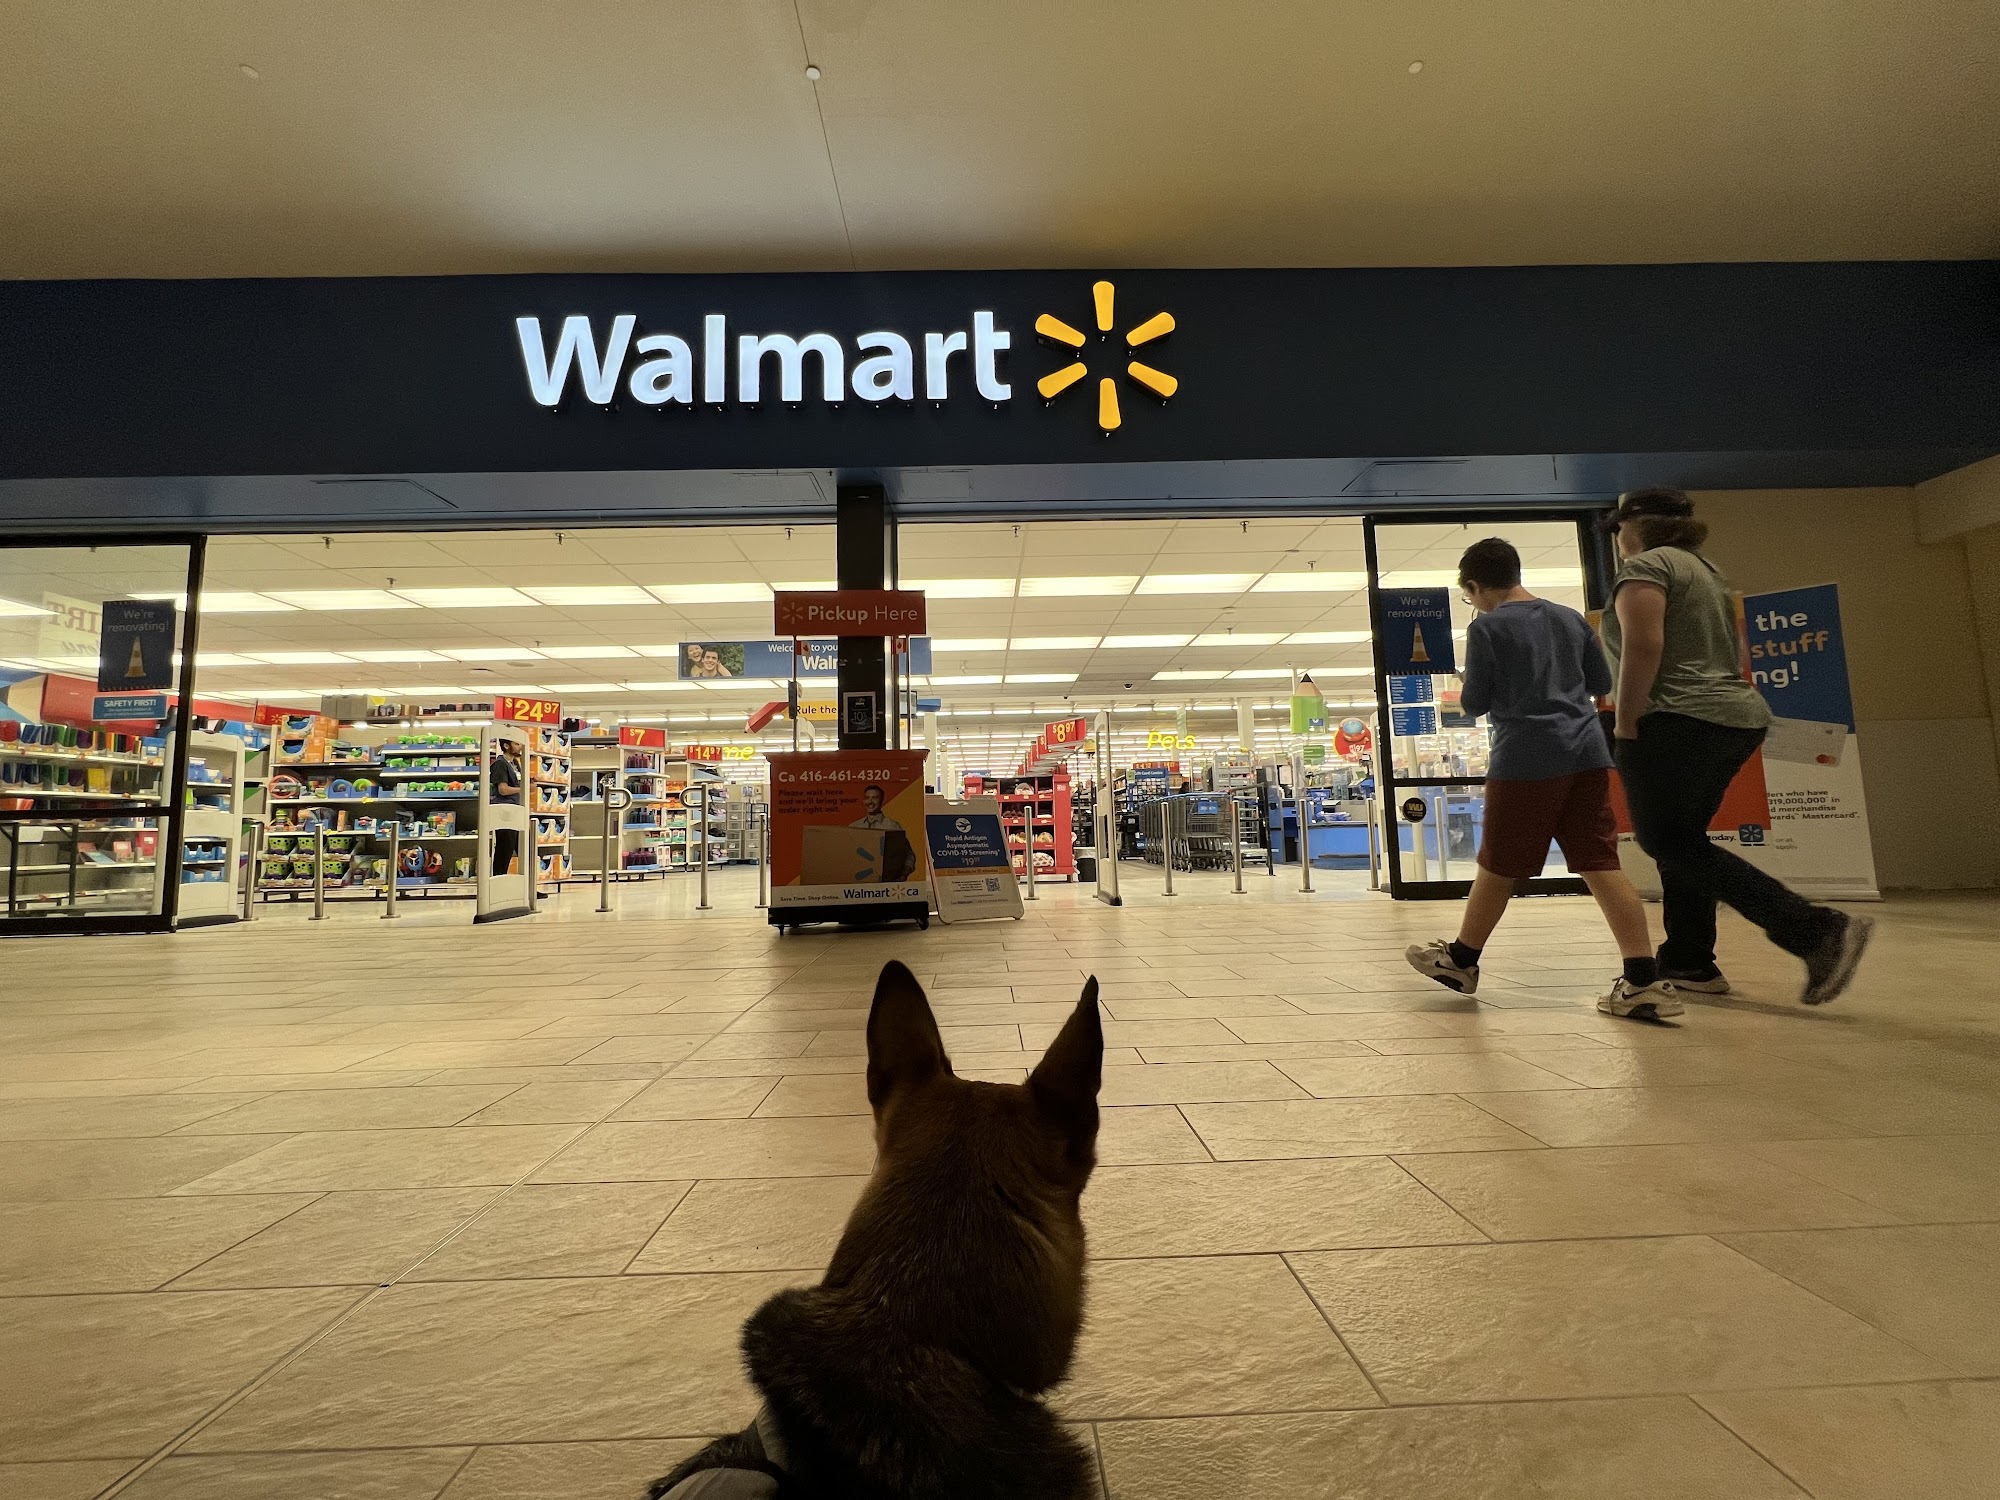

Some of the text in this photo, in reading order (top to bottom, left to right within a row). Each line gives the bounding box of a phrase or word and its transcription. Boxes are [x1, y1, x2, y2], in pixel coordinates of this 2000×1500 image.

[516, 311, 1012, 406] Walmart
[1400, 596, 1430, 606] We're
[123, 609, 154, 619] We're
[808, 605, 918, 625] Pickup Here
[1387, 608, 1445, 619] renovating!
[107, 620, 169, 633] renovating!
[1755, 610, 1808, 632] the
[768, 644, 794, 652] Welco
[822, 645, 838, 653] you
[1750, 630, 1829, 659] stuff
[104, 698, 157, 708] SAFETY FIRST!
[820, 705, 837, 714] the
[800, 769, 891, 782] 416-461-4320
[803, 806, 823, 814] right
[843, 887, 919, 899] Walmart ca
